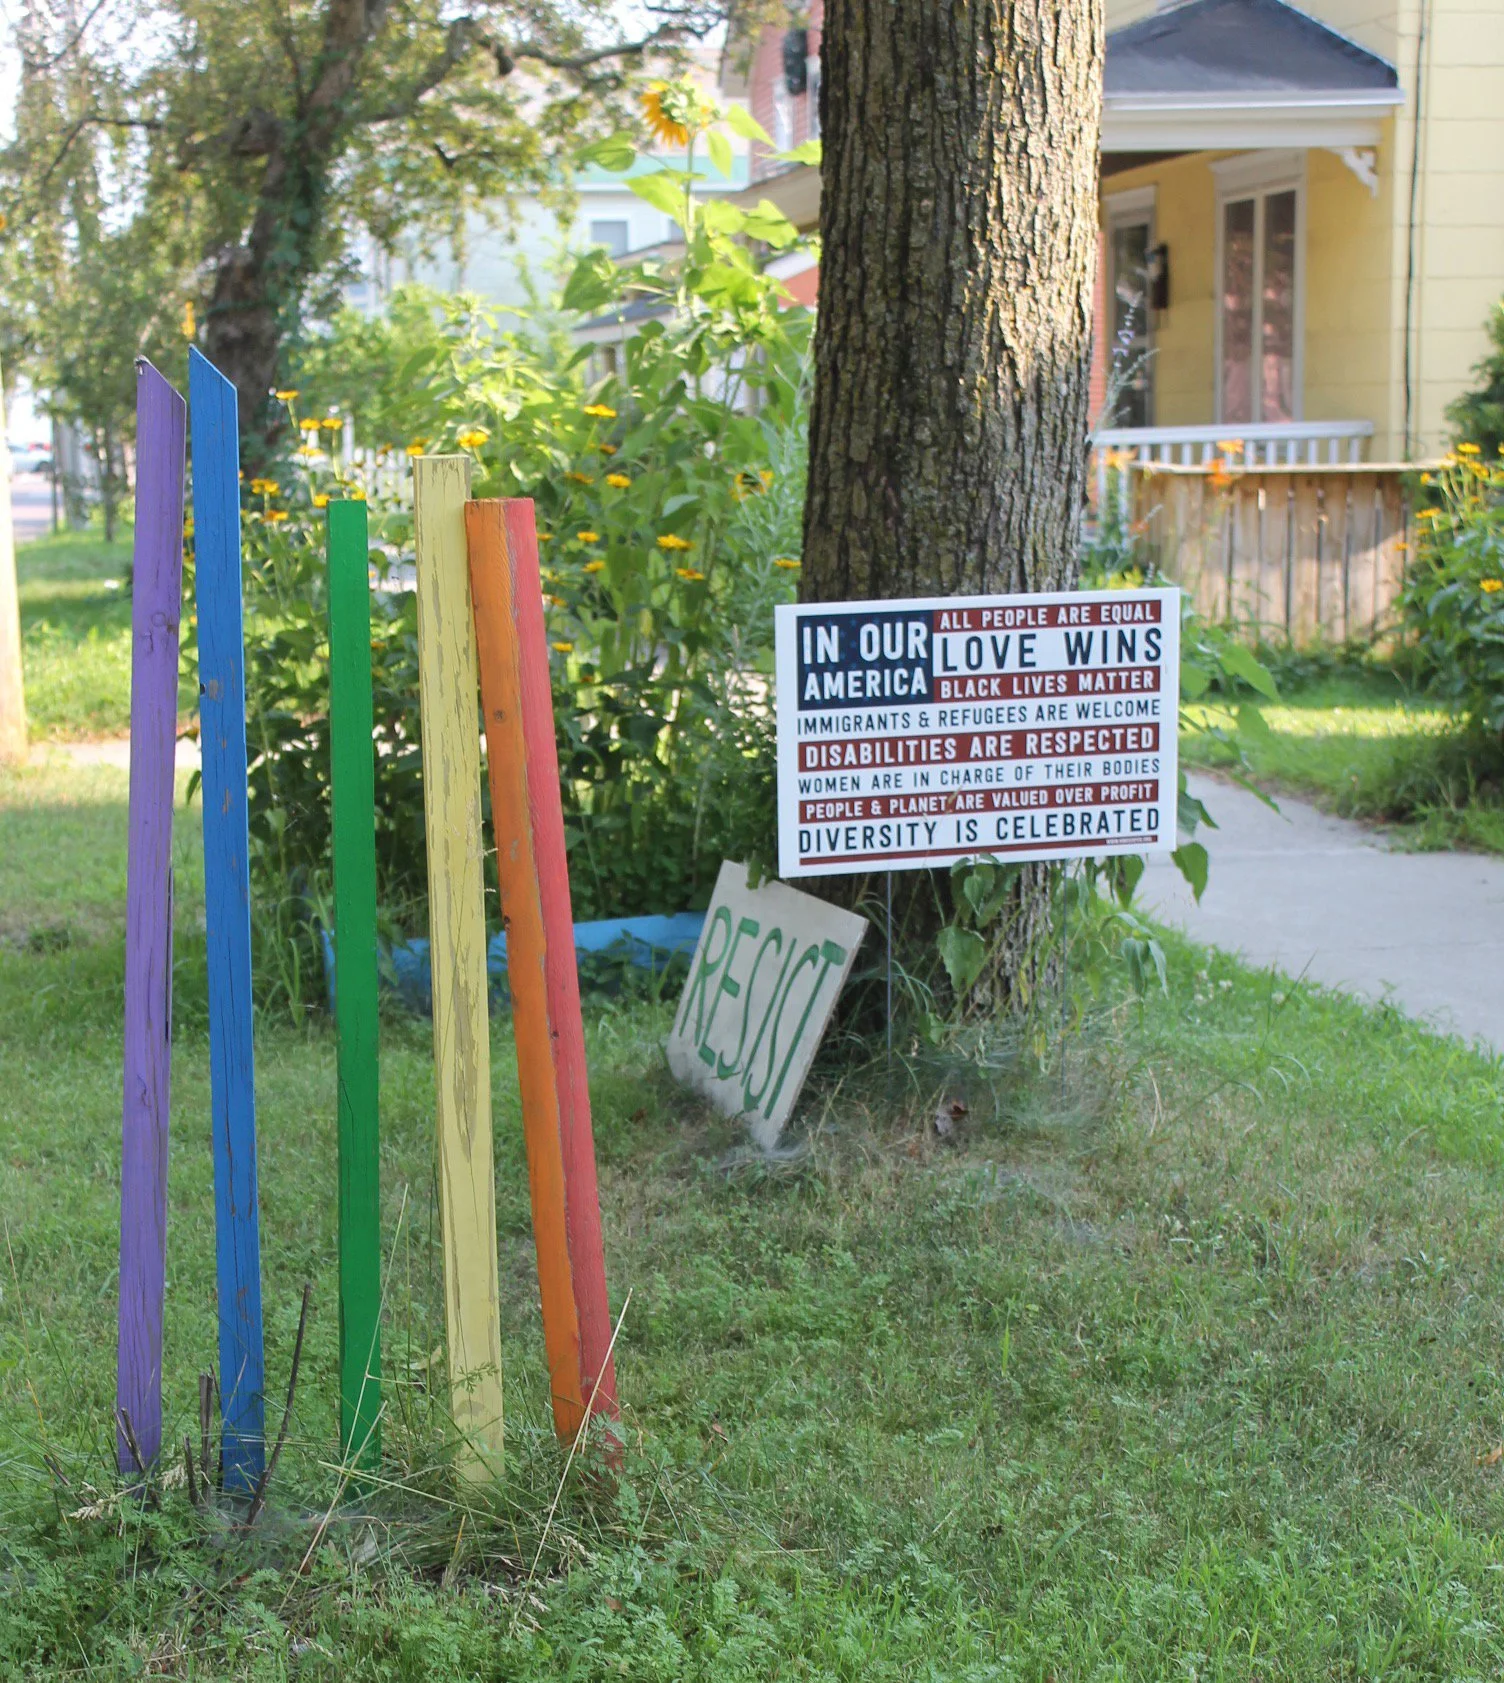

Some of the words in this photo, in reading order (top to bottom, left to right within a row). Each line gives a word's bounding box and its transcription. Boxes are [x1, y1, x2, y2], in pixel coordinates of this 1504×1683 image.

[939, 611, 971, 630] ALL
[982, 608, 1048, 628] PEOPLE
[1057, 606, 1090, 624] ARE
[1101, 603, 1154, 624] EQUAL
[803, 626, 840, 664] IN
[859, 622, 928, 661] OUR
[943, 634, 1037, 672] LOVE
[1065, 628, 1162, 665] WINS
[804, 667, 927, 701] AMERICA
[940, 678, 1001, 699] BLACK
[1013, 675, 1067, 695] LIVES
[1078, 670, 1154, 691] MATTER
[797, 712, 910, 735] IMMIGRANTS
[919, 711, 929, 727] &
[939, 706, 1027, 727] REFUGEES
[1035, 704, 1068, 721] ARE
[1077, 699, 1160, 720] WELCOME
[806, 737, 957, 768] DISABILITIES
[970, 734, 1013, 758] ARE
[1025, 727, 1154, 755] RESPECTED
[798, 776, 860, 795] WOMEN
[872, 773, 902, 789] ARE
[914, 771, 929, 787] IN
[940, 767, 1004, 785] CHARGE
[1015, 765, 1034, 781] OF
[1045, 763, 1091, 779] THEIR
[1103, 759, 1160, 776] BODIES
[806, 802, 862, 819] PEOPLE
[871, 801, 881, 815] &
[890, 796, 947, 814] PLANET
[956, 793, 984, 810] ARE
[992, 789, 1048, 808] VALUED
[1055, 787, 1093, 804] OVER
[1101, 783, 1153, 801] PROFIT
[799, 822, 937, 854] DIVERSITY
[956, 819, 978, 843] IS
[996, 808, 1159, 840] CELEBRATED
[679, 905, 848, 1119] RESIST
